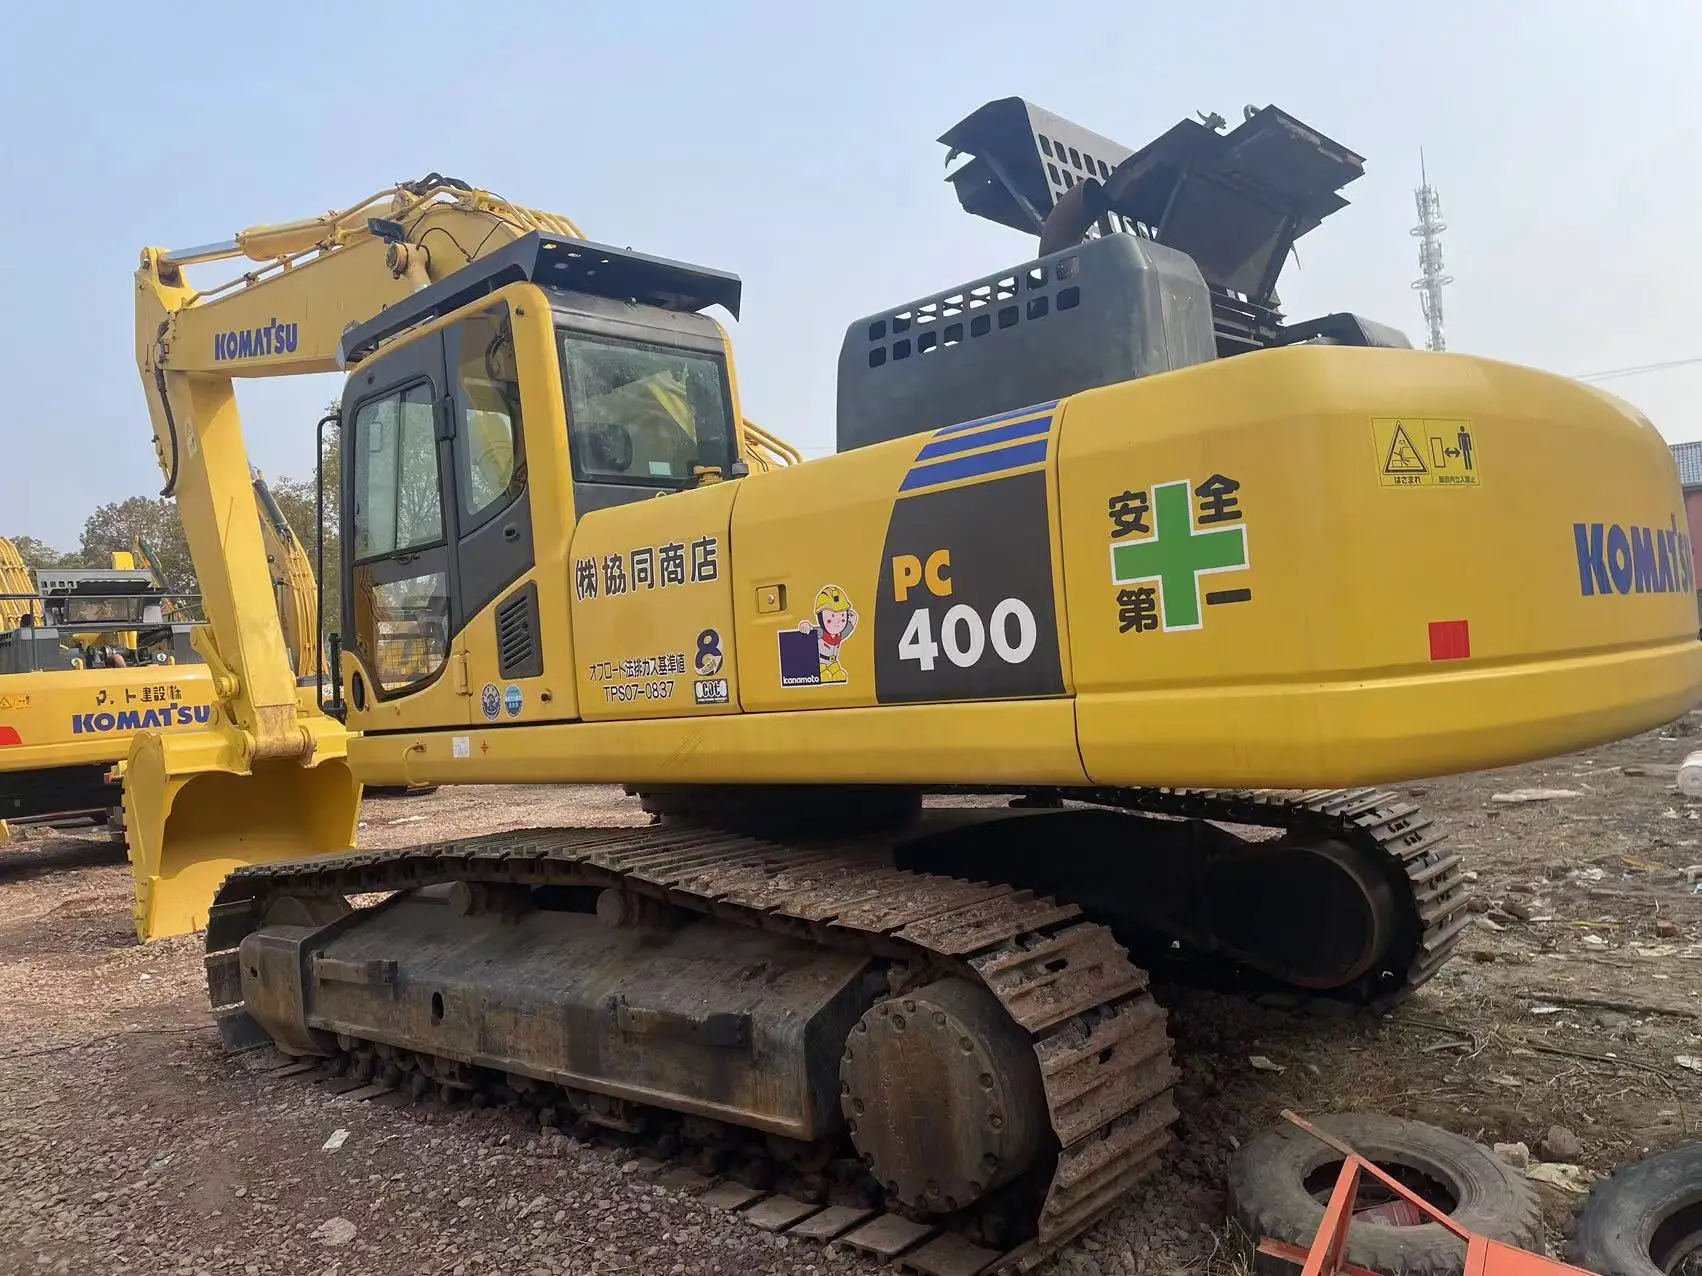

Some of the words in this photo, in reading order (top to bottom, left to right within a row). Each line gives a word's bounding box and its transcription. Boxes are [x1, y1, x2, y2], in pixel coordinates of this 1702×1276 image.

[215, 318, 298, 360] KOMATSU
[1394, 476, 1421, 484] はさまれ
[1109, 490, 1149, 538] 安
[1195, 474, 1242, 524] 全
[892, 549, 952, 602] PC
[1117, 587, 1158, 634] 第
[898, 598, 1037, 671] 400
[783, 675, 820, 685] kanamoto
[72, 702, 210, 734] KOMATSU
